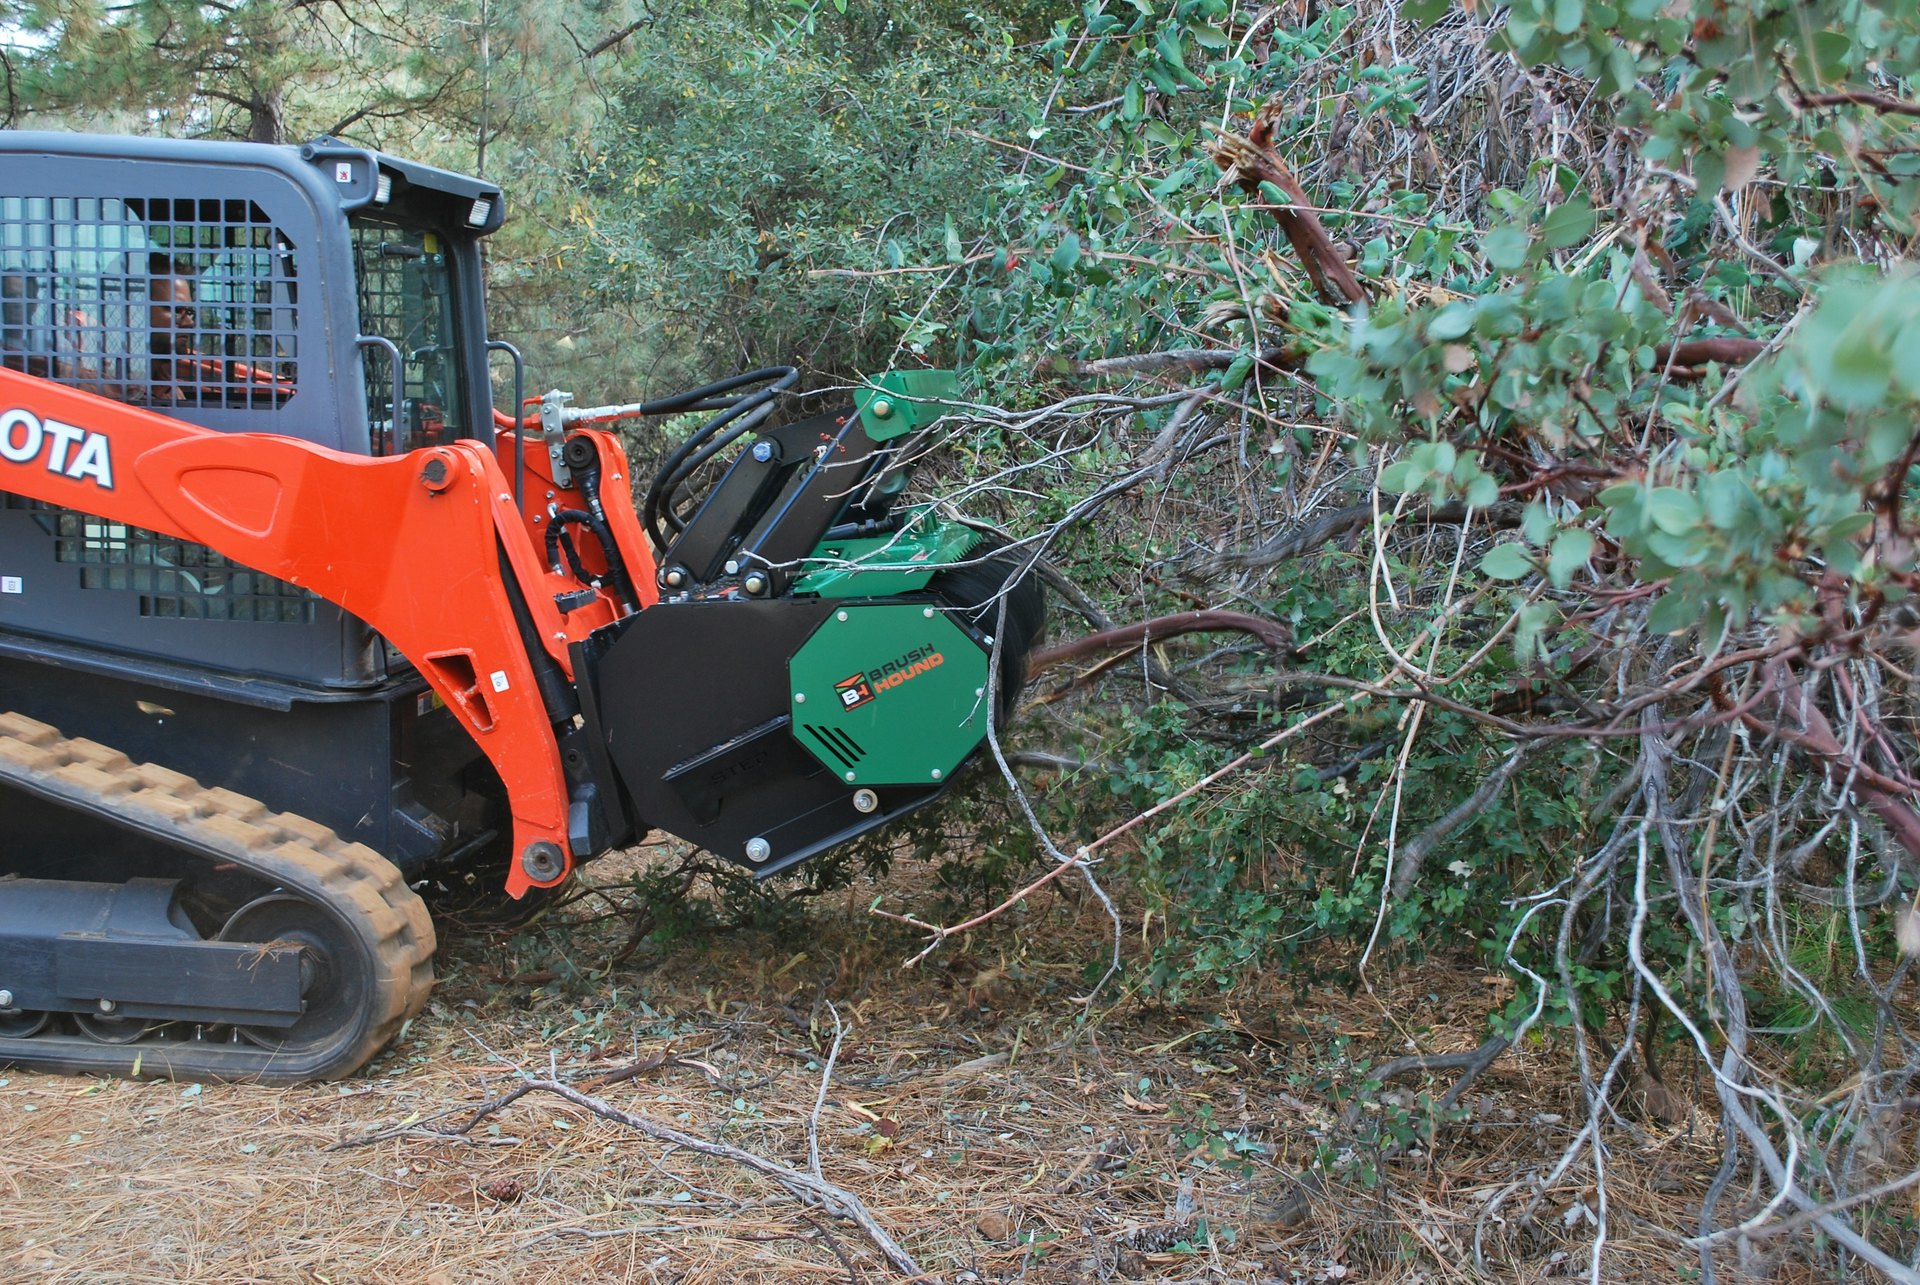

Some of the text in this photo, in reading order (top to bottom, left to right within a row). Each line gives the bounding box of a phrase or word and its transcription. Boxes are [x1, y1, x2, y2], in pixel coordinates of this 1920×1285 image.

[0, 408, 113, 489] OTA
[869, 643, 935, 682] BRUSH
[874, 652, 944, 694] HOUND
